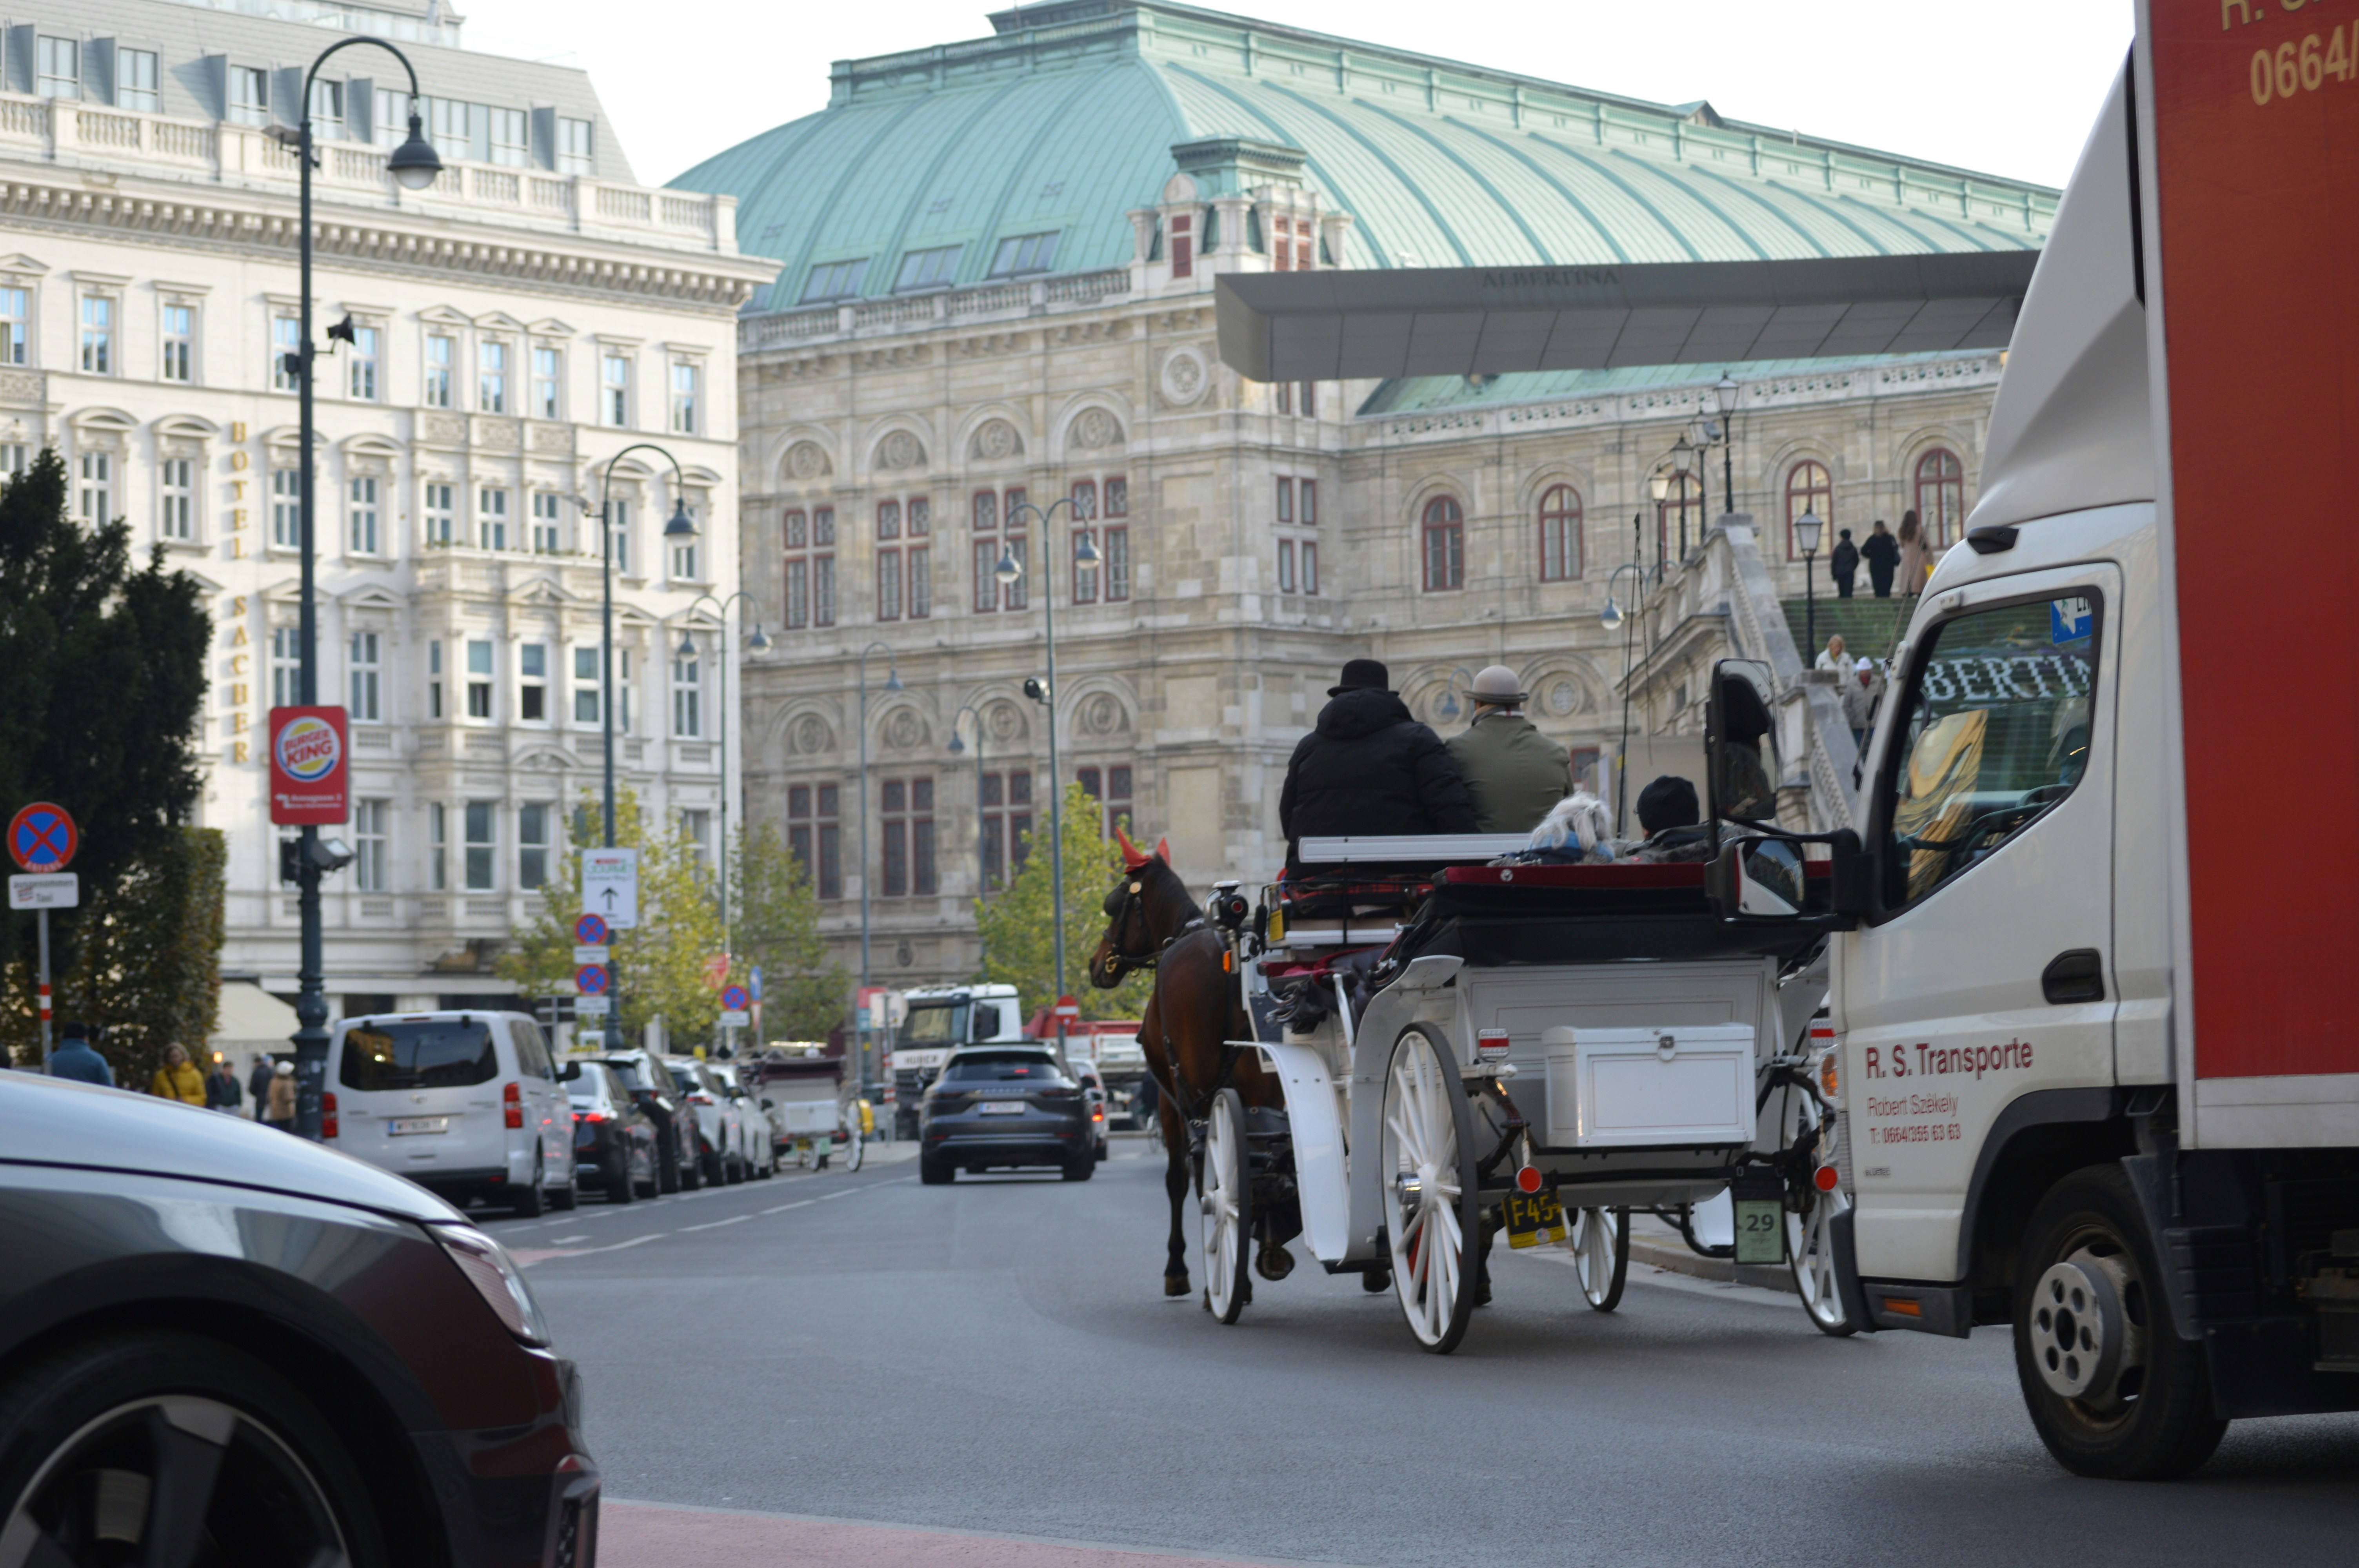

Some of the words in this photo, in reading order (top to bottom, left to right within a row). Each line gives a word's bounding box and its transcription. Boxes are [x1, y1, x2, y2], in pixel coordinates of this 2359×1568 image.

[1482, 269, 1619, 288] ALBERTINA
[231, 421, 248, 560] HOTEL
[232, 595, 249, 764] SACHER
[284, 730, 329, 752] BURGER
[287, 740, 333, 768] KING
[1866, 1047, 1886, 1079] R.
[1892, 1044, 1912, 1077] S.
[1916, 1037, 2034, 1080] Transporte
[1867, 1096, 1908, 1118] Robert
[1883, 1125, 1929, 1144] 0664/355
[1931, 1123, 1945, 1141] 63
[1947, 1123, 1961, 1140] 63
[1747, 1214, 1775, 1232] 29
